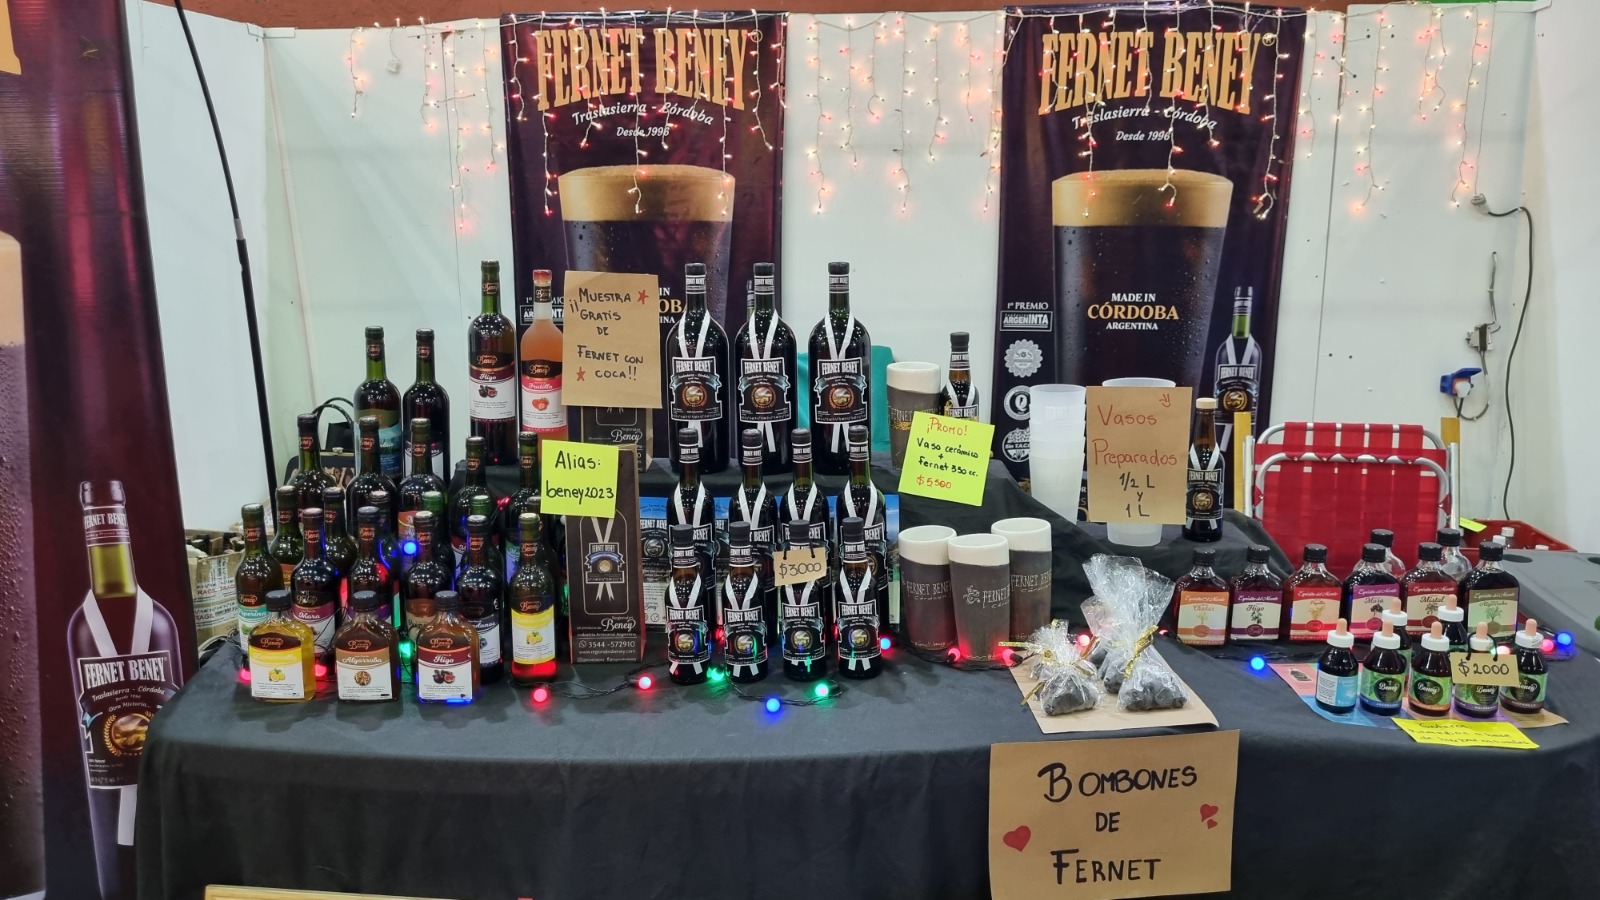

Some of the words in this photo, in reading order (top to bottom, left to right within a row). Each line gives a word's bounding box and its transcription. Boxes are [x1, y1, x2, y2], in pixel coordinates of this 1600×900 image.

[535, 27, 644, 112] FERNET
[655, 27, 748, 112] BENEY
[1038, 31, 1154, 116] FERNET
[1160, 31, 1262, 115] BENEY
[1116, 130, 1147, 142] Desde
[1147, 130, 1171, 142] 1996
[1015, 301, 1049, 310] PREMIO
[1111, 293, 1143, 302] MADE
[1144, 293, 1156, 303] IN
[1087, 300, 1179, 321] CÓRDOBA
[596, 326, 609, 336] DE
[1105, 321, 1159, 331] ARGENTINA
[577, 344, 620, 363] FERNET
[624, 355, 644, 365] CON
[1097, 404, 1157, 427] Vasos
[916, 437, 942, 452] Vaso
[1092, 437, 1178, 469] Preparados
[555, 450, 602, 470] Alias:
[1119, 471, 1140, 491] 1/2
[1146, 474, 1156, 489] L
[546, 479, 615, 505] beney2023
[1125, 503, 1132, 518] 1
[1138, 504, 1150, 518] L
[1246, 604, 1264, 613] Higo
[601, 617, 637, 632] Beney
[84, 660, 126, 690] FERNET
[128, 656, 166, 682] BENEY
[91, 687, 130, 703] Traslasierra
[1037, 762, 1198, 803] BOMBONES
[1096, 811, 1121, 833] DE
[1050, 848, 1162, 885] FERNET
